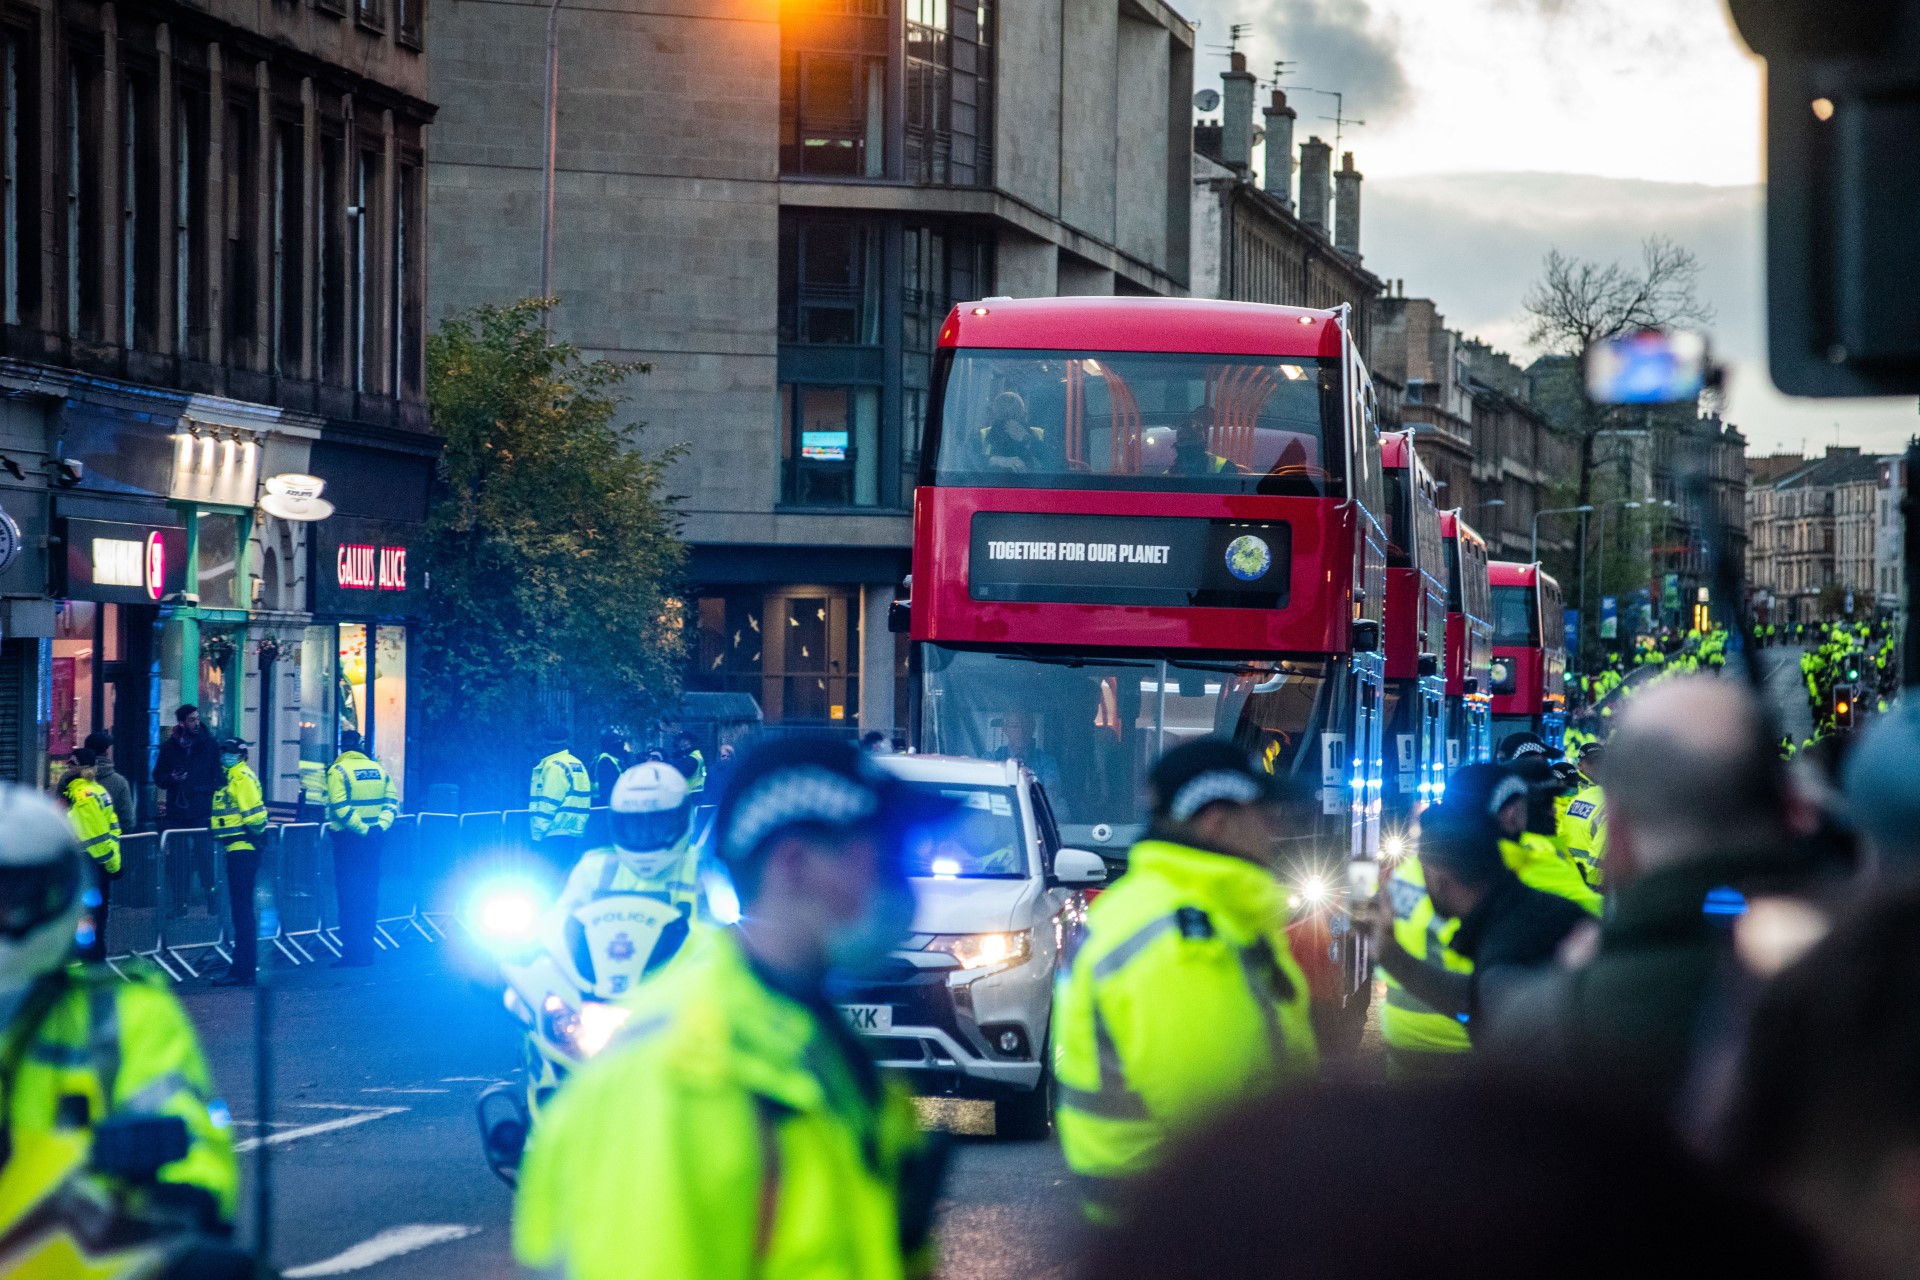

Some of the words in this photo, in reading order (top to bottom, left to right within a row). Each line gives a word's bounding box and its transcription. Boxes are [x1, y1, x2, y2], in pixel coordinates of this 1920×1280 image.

[988, 541, 1056, 560] TOGETHER
[1058, 542, 1085, 561] FOR
[1087, 543, 1117, 562] OUR
[1118, 544, 1170, 563] PLANET
[337, 544, 375, 590] GALLUS
[379, 546, 406, 590] ALICE
[1328, 740, 1343, 769] 10
[1405, 739, 1411, 760] 9
[591, 911, 657, 927] POLICE
